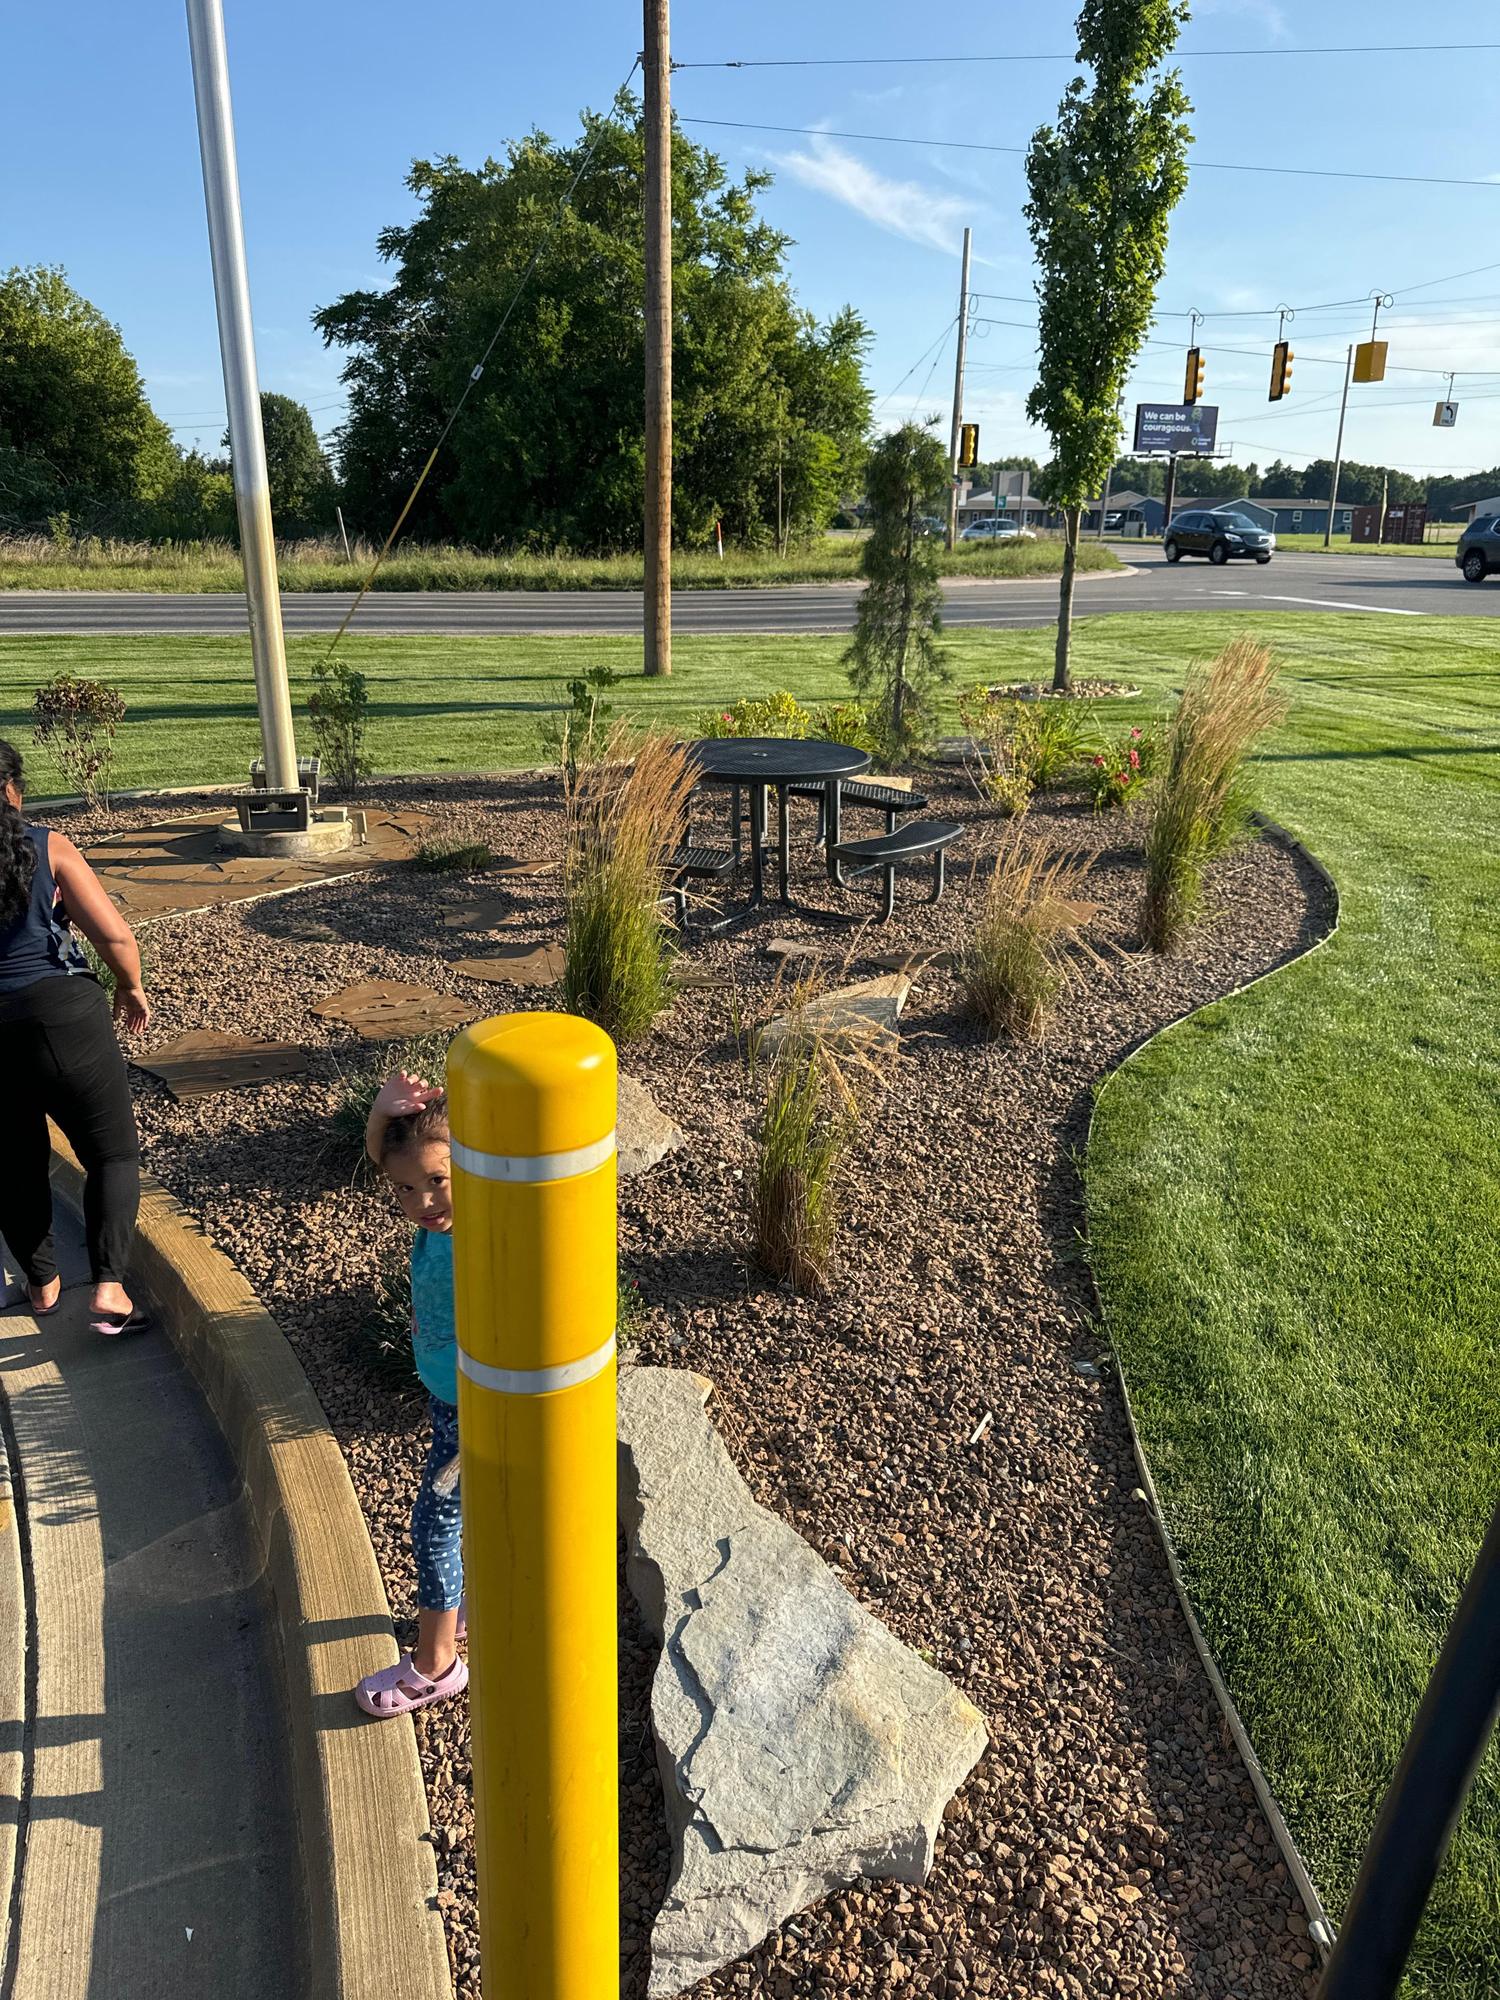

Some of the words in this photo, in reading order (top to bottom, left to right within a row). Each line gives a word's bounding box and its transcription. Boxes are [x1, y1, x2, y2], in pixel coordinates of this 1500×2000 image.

[1144, 411, 1158, 420] We
[1159, 412, 1174, 421] can
[1175, 412, 1186, 421] be
[1143, 424, 1192, 434] courageous.
